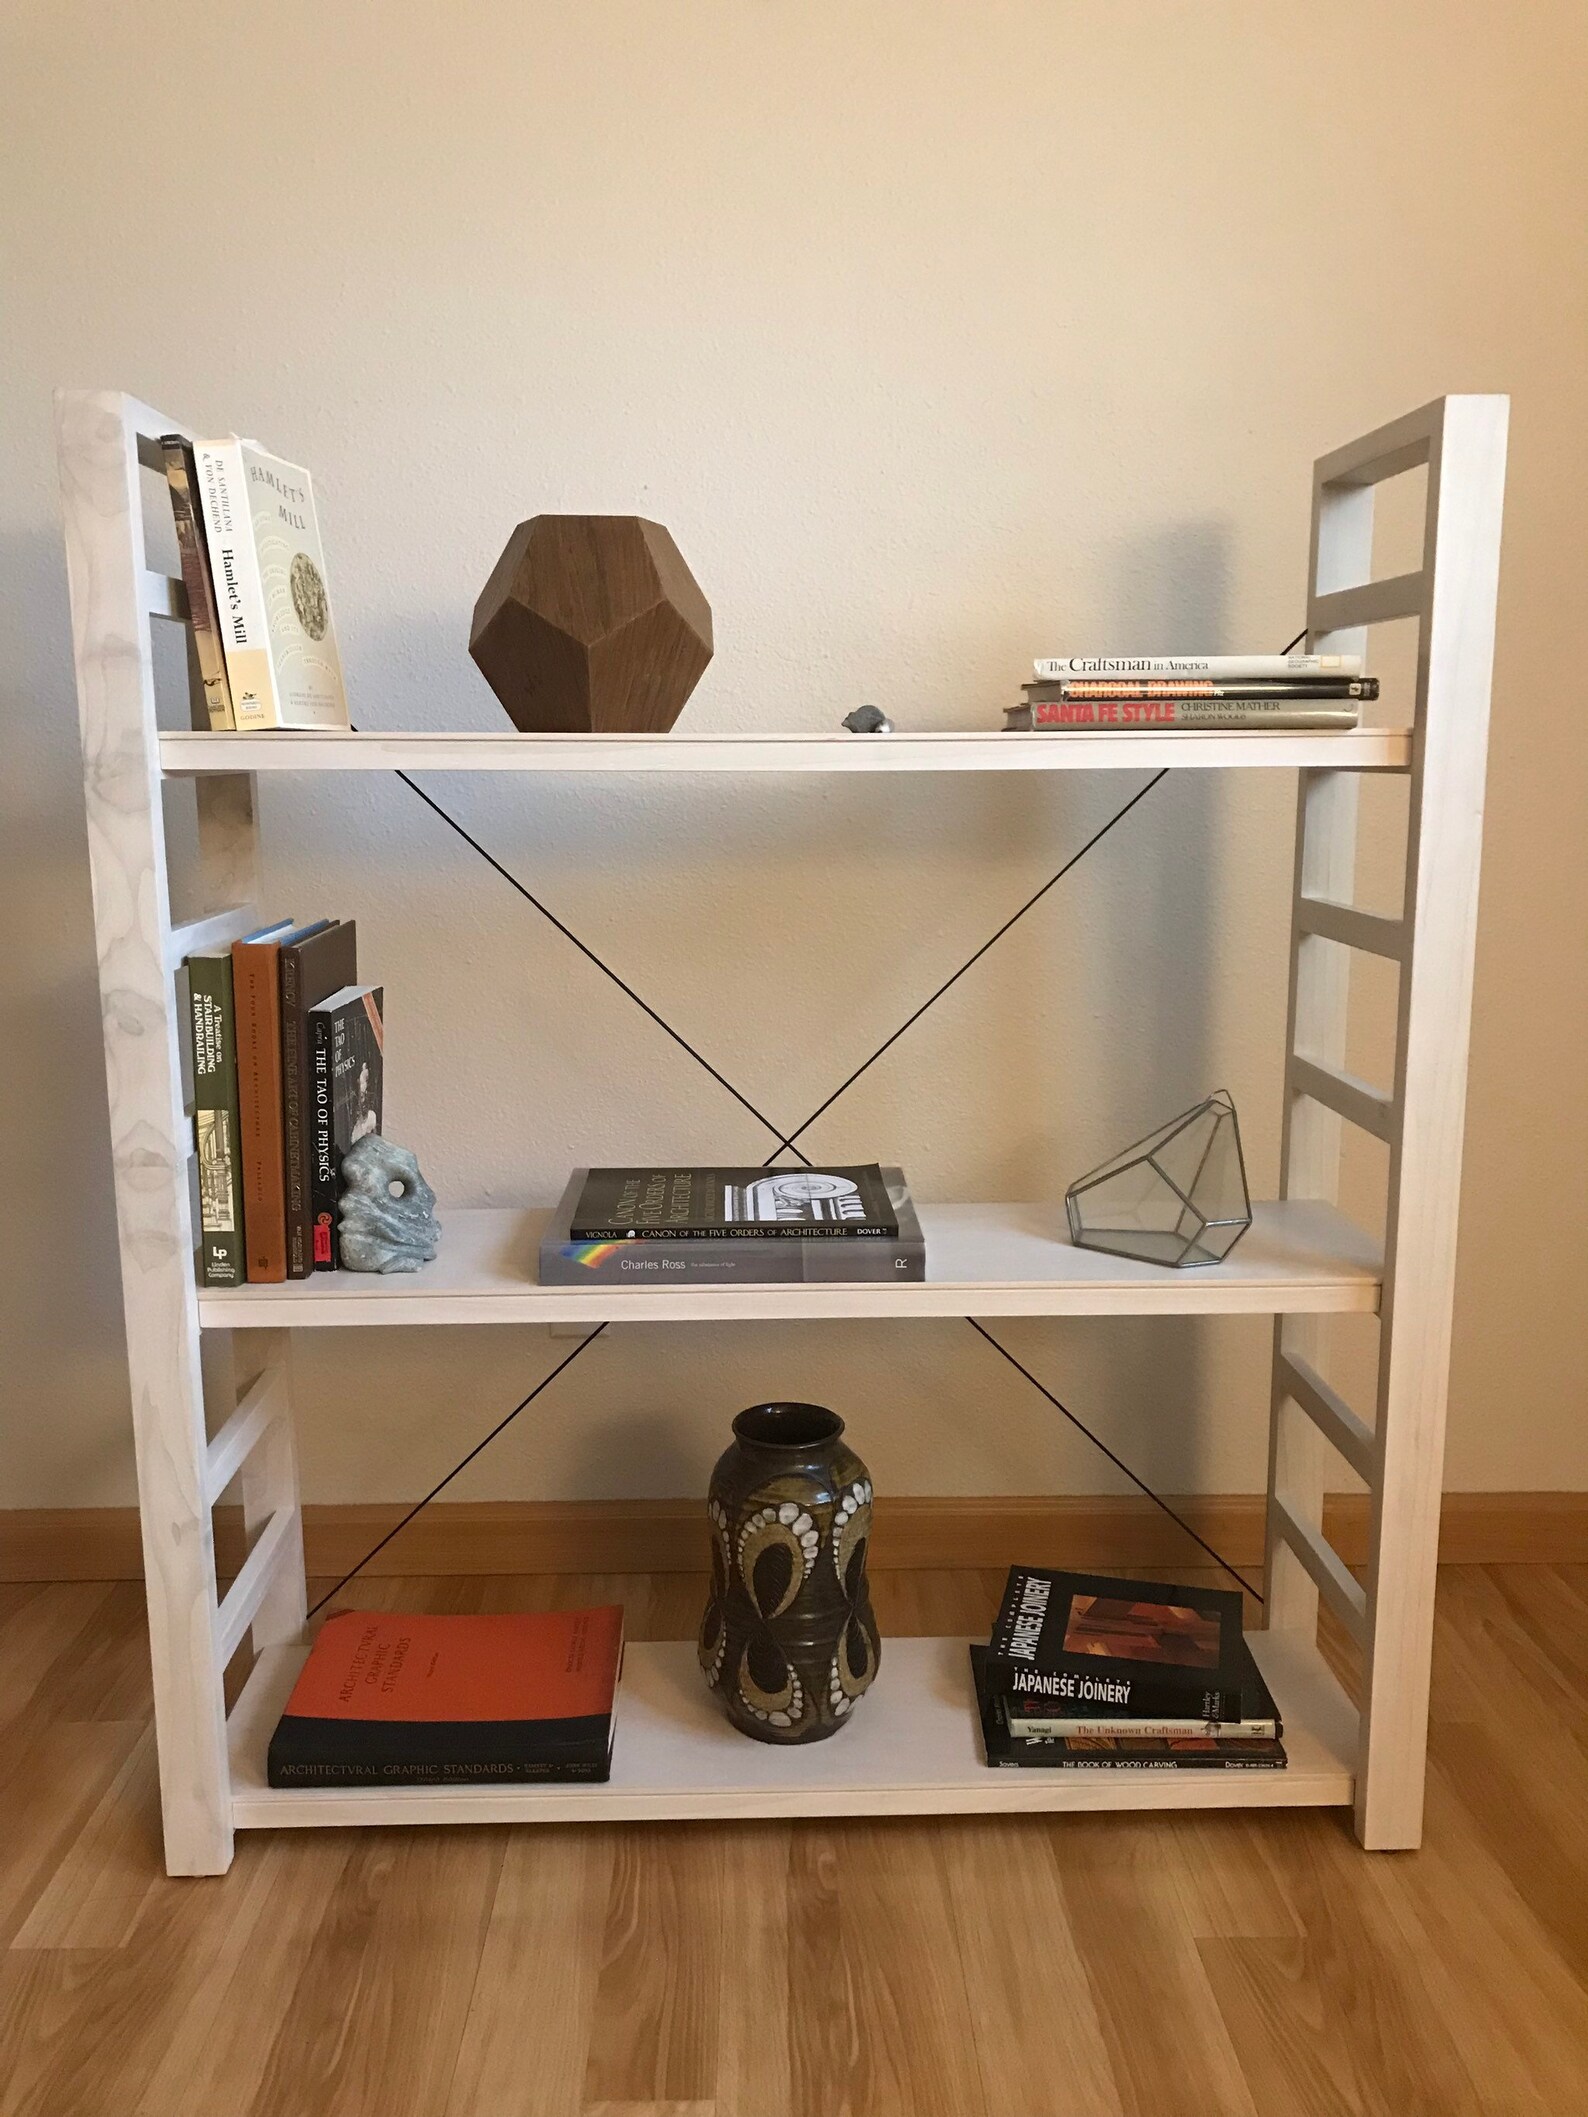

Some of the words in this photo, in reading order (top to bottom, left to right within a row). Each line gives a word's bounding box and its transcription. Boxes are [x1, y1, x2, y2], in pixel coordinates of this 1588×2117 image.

[202, 453, 210, 461] &
[205, 464, 214, 483] VON
[250, 466, 305, 502] HAMLET'S
[209, 488, 222, 533] DECHEND
[219, 477, 233, 532] SANTILLANA
[279, 505, 306, 530] MILL
[222, 549, 242, 610] Hamlet's
[232, 616, 248, 644] Mill
[1047, 660, 1067, 672] The
[1069, 658, 1151, 672] Craftsman
[1154, 660, 1164, 670] in
[1165, 660, 1209, 670] America
[1147, 680, 1214, 698] DRAWING
[1036, 703, 1095, 724] SANTA
[1098, 703, 1118, 722] FE
[1122, 702, 1176, 722] STYLE
[1181, 702, 1236, 711] CHRISTINE
[1236, 701, 1280, 711] MATHER
[194, 992, 202, 1002] &
[214, 1004, 222, 1012] A
[204, 994, 216, 1073] STAIRBUILDING
[214, 1014, 222, 1050] Treatise
[334, 1018, 345, 1034] THE
[194, 1004, 206, 1074] HANDRAILING
[334, 1033, 346, 1048] TAO
[216, 1052, 222, 1063] on
[316, 1048, 327, 1074] THE
[335, 1049, 343, 1063] OF
[335, 1055, 356, 1078] PHYSICS
[316, 1080, 328, 1104] TAO
[317, 1108, 328, 1126] OF
[318, 1130, 330, 1182] PHYSICS
[642, 1230, 676, 1238] CANON
[730, 1228, 764, 1237] ORDERS
[780, 1228, 848, 1236] ARCHITECTURE
[620, 1260, 659, 1270] Charles
[662, 1260, 686, 1270] Ross
[895, 1258, 908, 1268] R
[1020, 1576, 1052, 1617] JOINERY
[1008, 1615, 1044, 1660] JAPANESE
[364, 1643, 391, 1684] GRAPHIC
[381, 1636, 411, 1693] STANDARDS
[1012, 1672, 1075, 1698] JAPANESE
[1078, 1680, 1131, 1704] JOINERY
[1027, 1726, 1052, 1735] Yanagi
[1076, 1725, 1094, 1734] The
[1098, 1725, 1141, 1734] Unknown
[1144, 1726, 1193, 1734] Craftsman
[384, 1764, 438, 1774] GRAPHIC
[444, 1764, 514, 1774] STANDARDS
